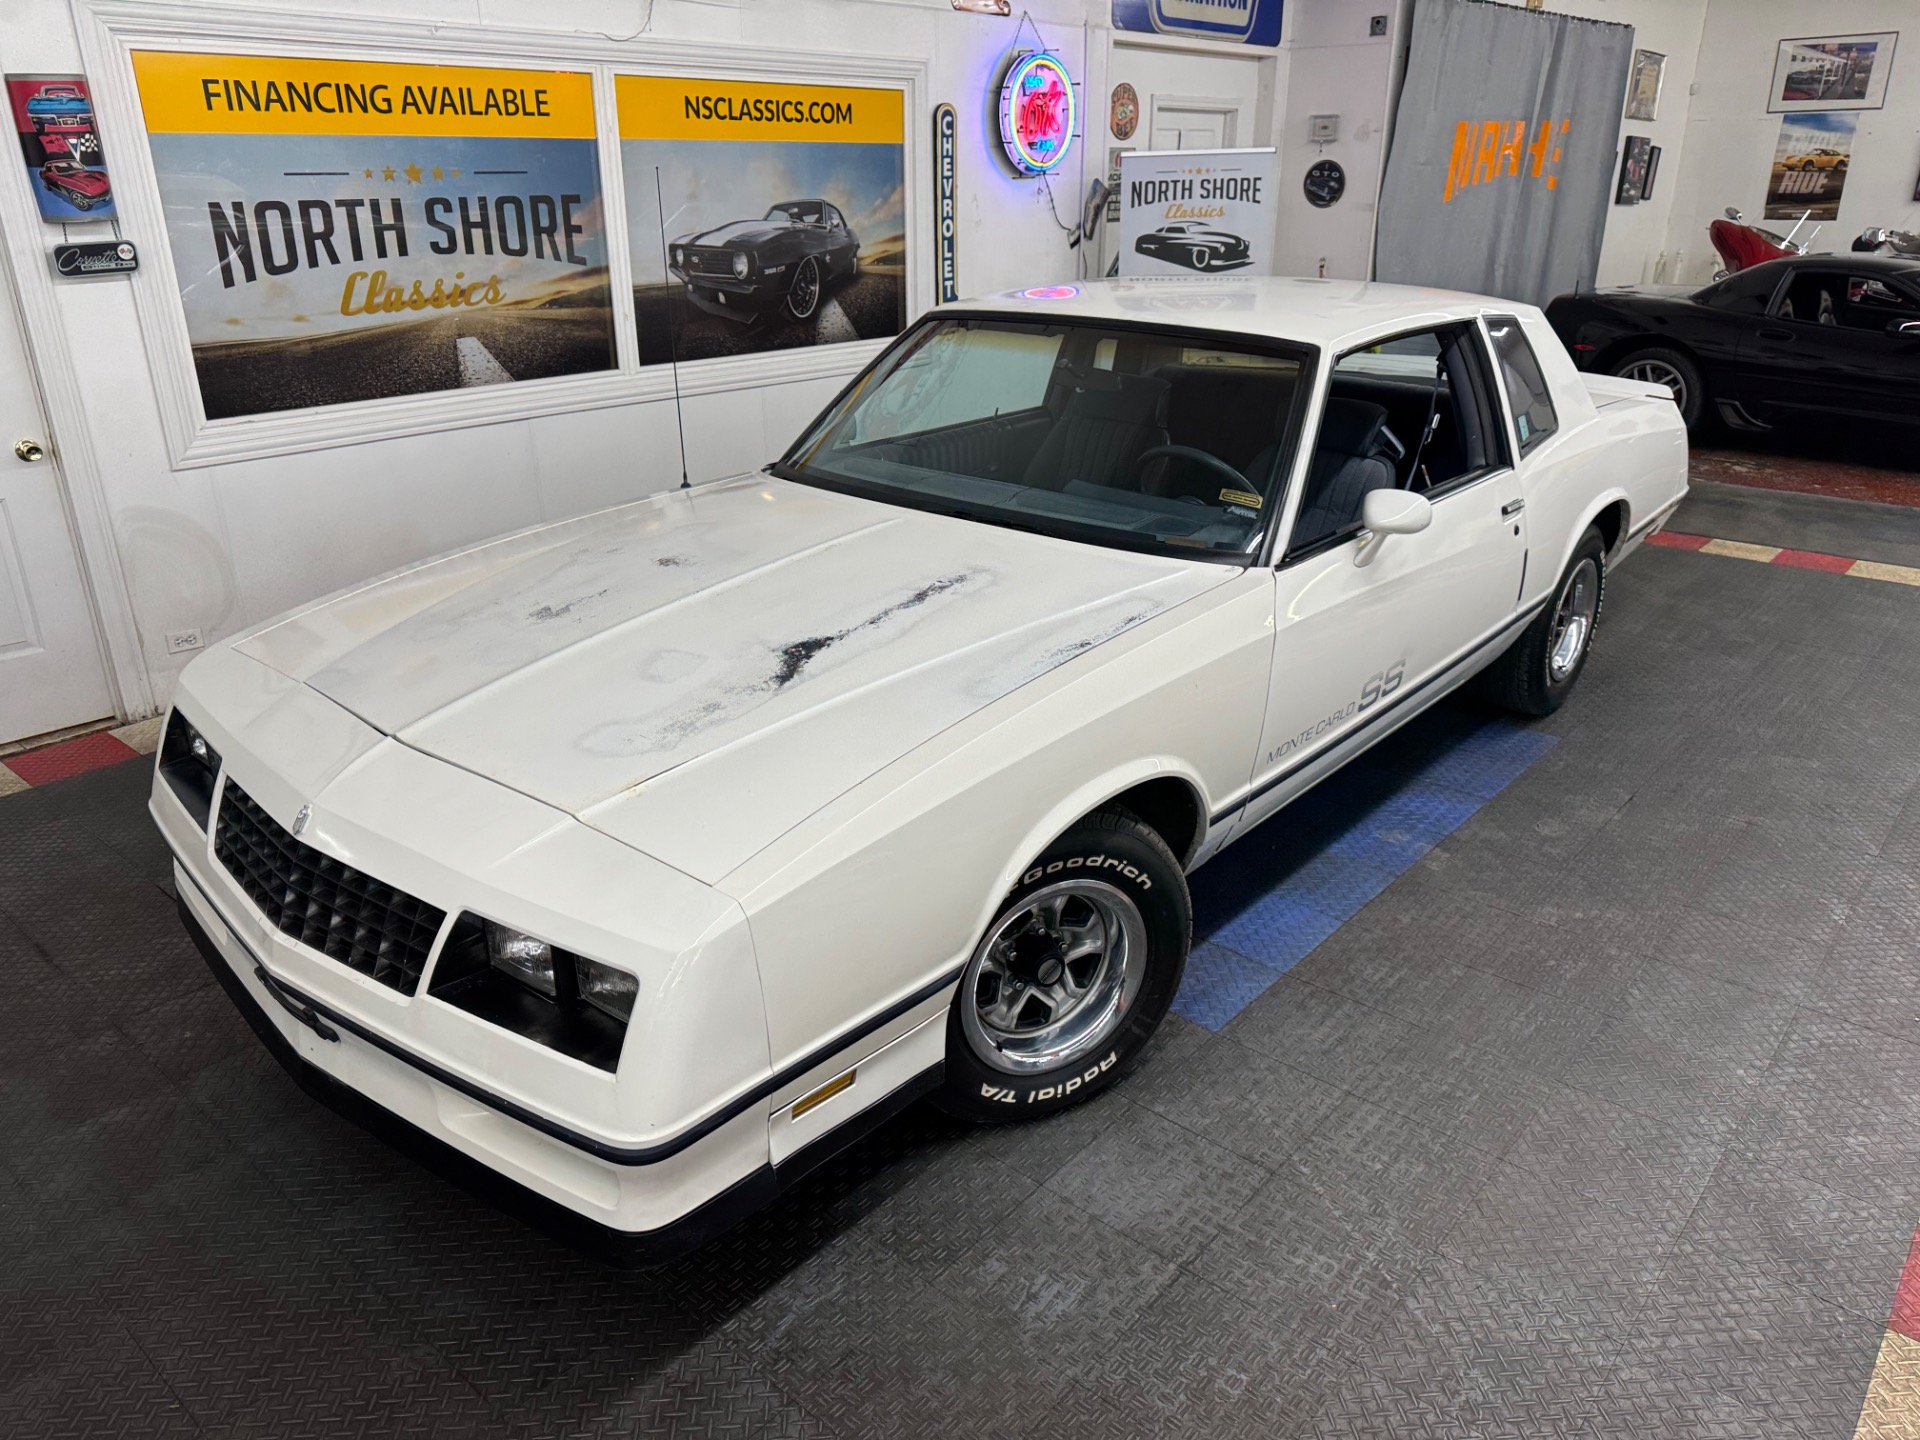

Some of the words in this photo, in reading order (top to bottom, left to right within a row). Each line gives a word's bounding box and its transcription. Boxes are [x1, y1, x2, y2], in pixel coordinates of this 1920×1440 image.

[201, 78, 393, 114] FINANCING
[401, 85, 550, 117] AVAILABLE
[684, 95, 852, 124] NSCLASSICS.COM
[1312, 170, 1340, 178] GTO
[1778, 171, 1828, 194] RIDE
[942, 115, 953, 298] CHEVROLET
[1131, 179, 1193, 209] NORTH
[1199, 177, 1262, 204] SHORE
[1164, 203, 1225, 219] Classics
[207, 198, 409, 288] NORTH
[424, 194, 588, 266] SHORE
[58, 248, 120, 271] Corvette
[340, 271, 507, 316] Classics
[1267, 726, 1315, 764] MONTE
[1315, 701, 1356, 735] CARLO
[1357, 658, 1407, 713] SS
[1006, 854, 1153, 896] Goodrich
[981, 1083, 1017, 1104] T/A
[1029, 1051, 1118, 1103] Radial
